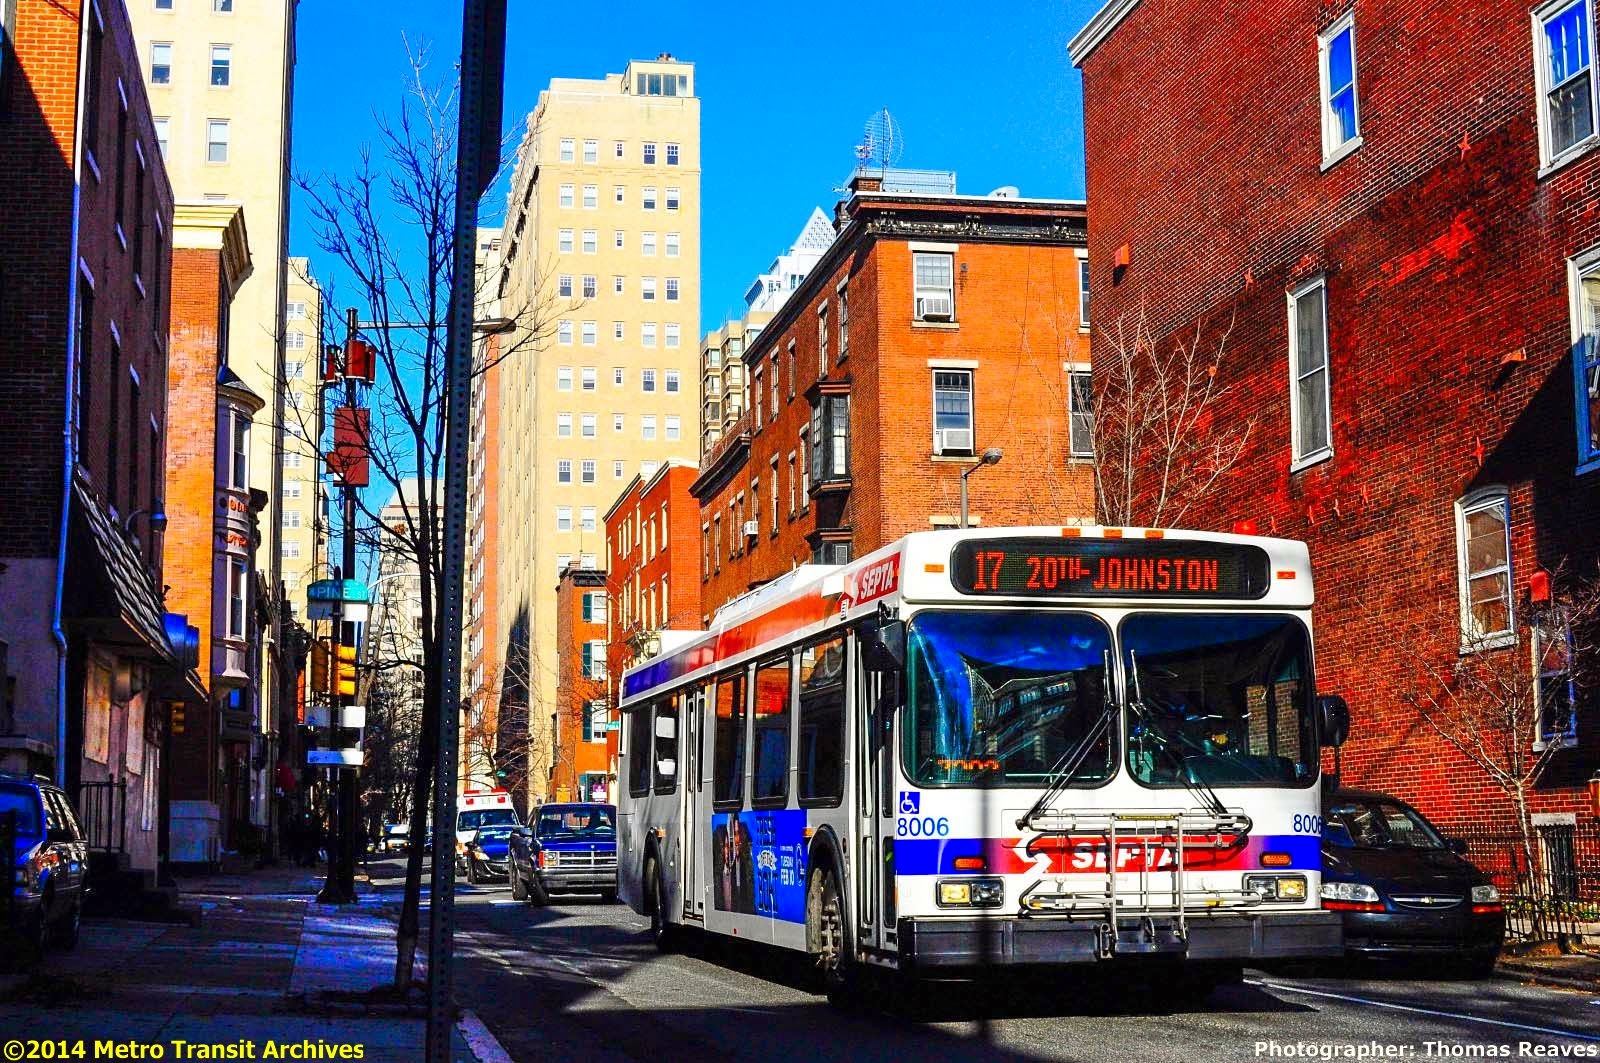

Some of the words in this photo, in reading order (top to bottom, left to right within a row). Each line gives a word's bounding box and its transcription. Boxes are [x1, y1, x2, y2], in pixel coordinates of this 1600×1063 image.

[860, 560, 895, 600] SEPTA
[974, 551, 1005, 590] 17
[897, 817, 949, 837] 8006
